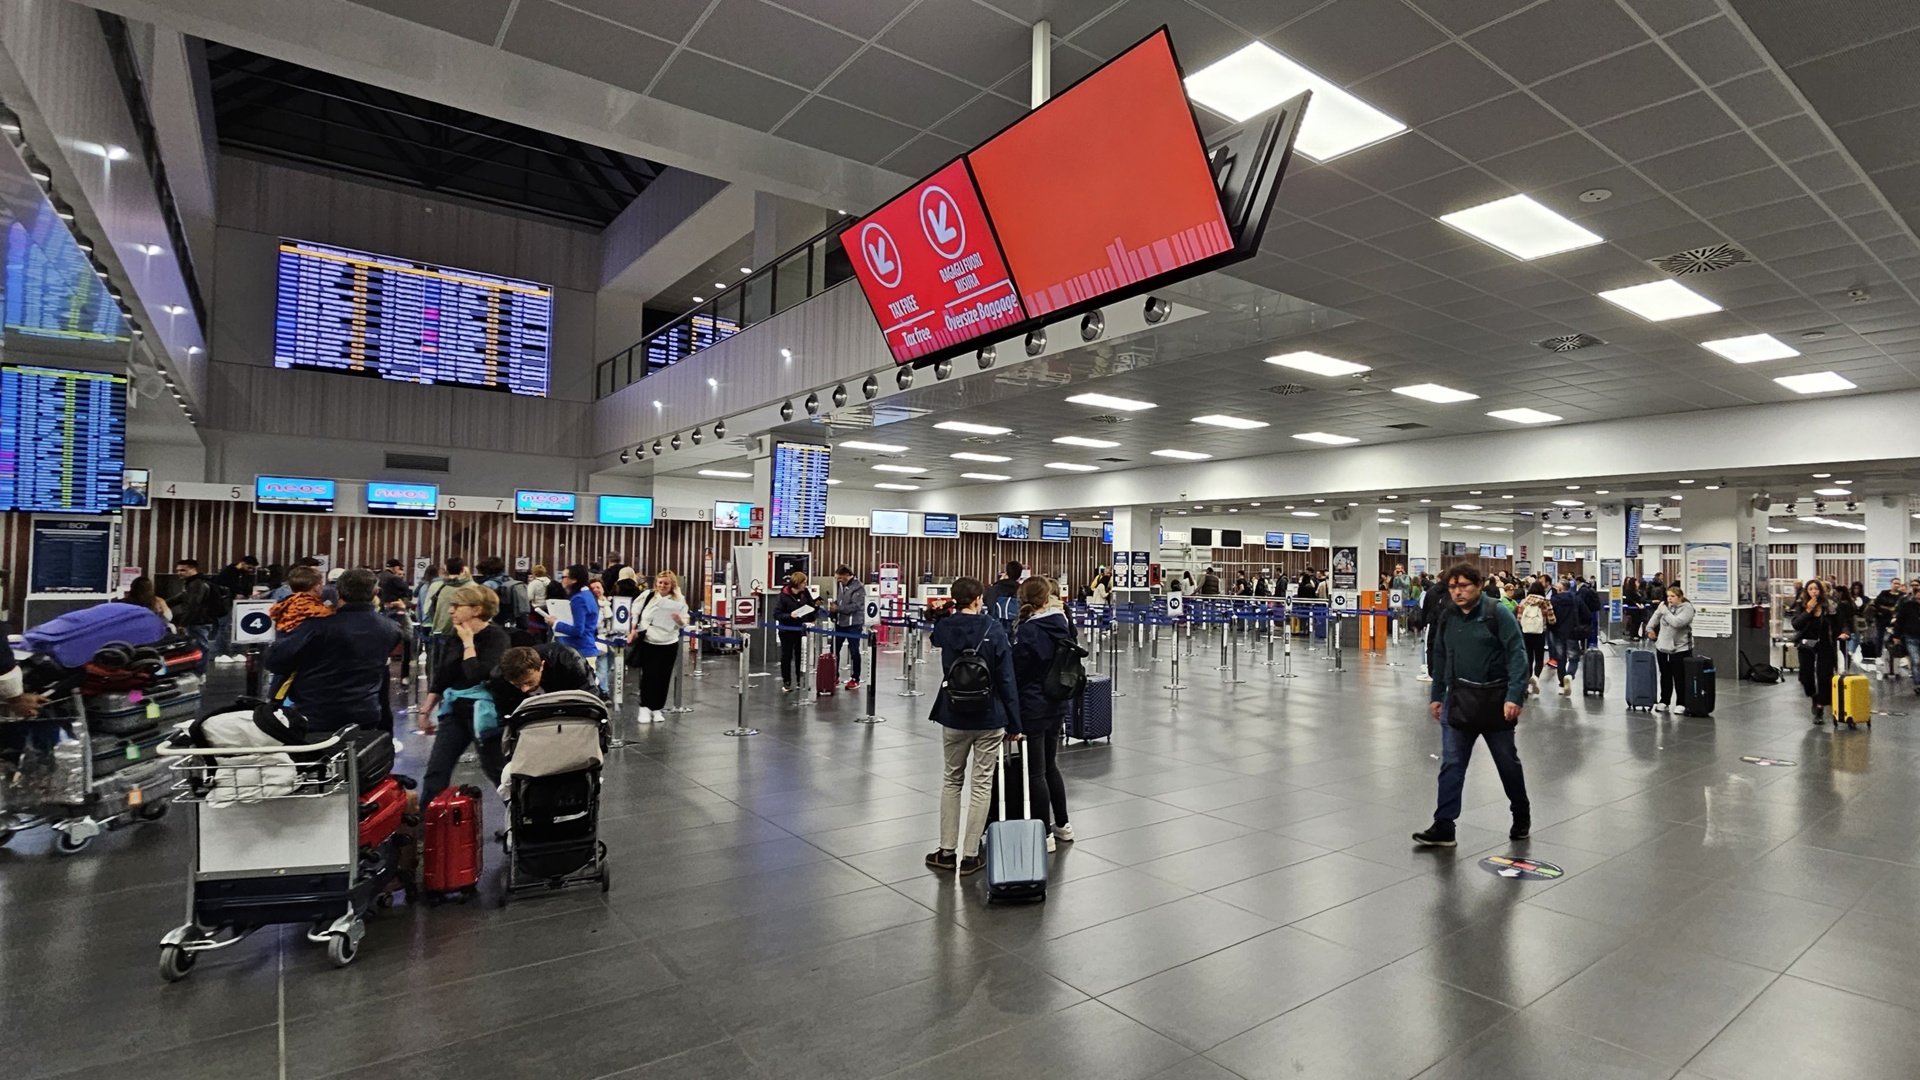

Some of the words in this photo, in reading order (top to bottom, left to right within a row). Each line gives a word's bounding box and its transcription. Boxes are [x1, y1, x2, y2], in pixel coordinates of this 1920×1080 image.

[939, 260, 964, 282] BAGAGLI
[963, 252, 983, 270] FUORI
[955, 273, 980, 293] MISURA
[888, 302, 904, 319] TAX
[901, 294, 920, 315] FREE
[944, 307, 979, 332] Oversize
[977, 293, 1018, 321] Baggage
[901, 331, 917, 347] Tax
[914, 326, 932, 344] free
[167, 483, 176, 496] 4
[230, 487, 240, 499] 5
[265, 483, 326, 494] neos
[375, 488, 429, 498] neos
[448, 497, 456, 508] 6
[522, 494, 570, 503] neos
[496, 500, 503, 510] 7
[661, 508, 668, 517] 8
[698, 509, 705, 519] 9
[826, 516, 836, 525] 10
[856, 517, 865, 525] 11
[961, 522, 969, 530] 12
[985, 523, 993, 531] 13
[619, 610, 625, 619] 6
[870, 606, 875, 614] 7
[250, 618, 263, 629] 4
